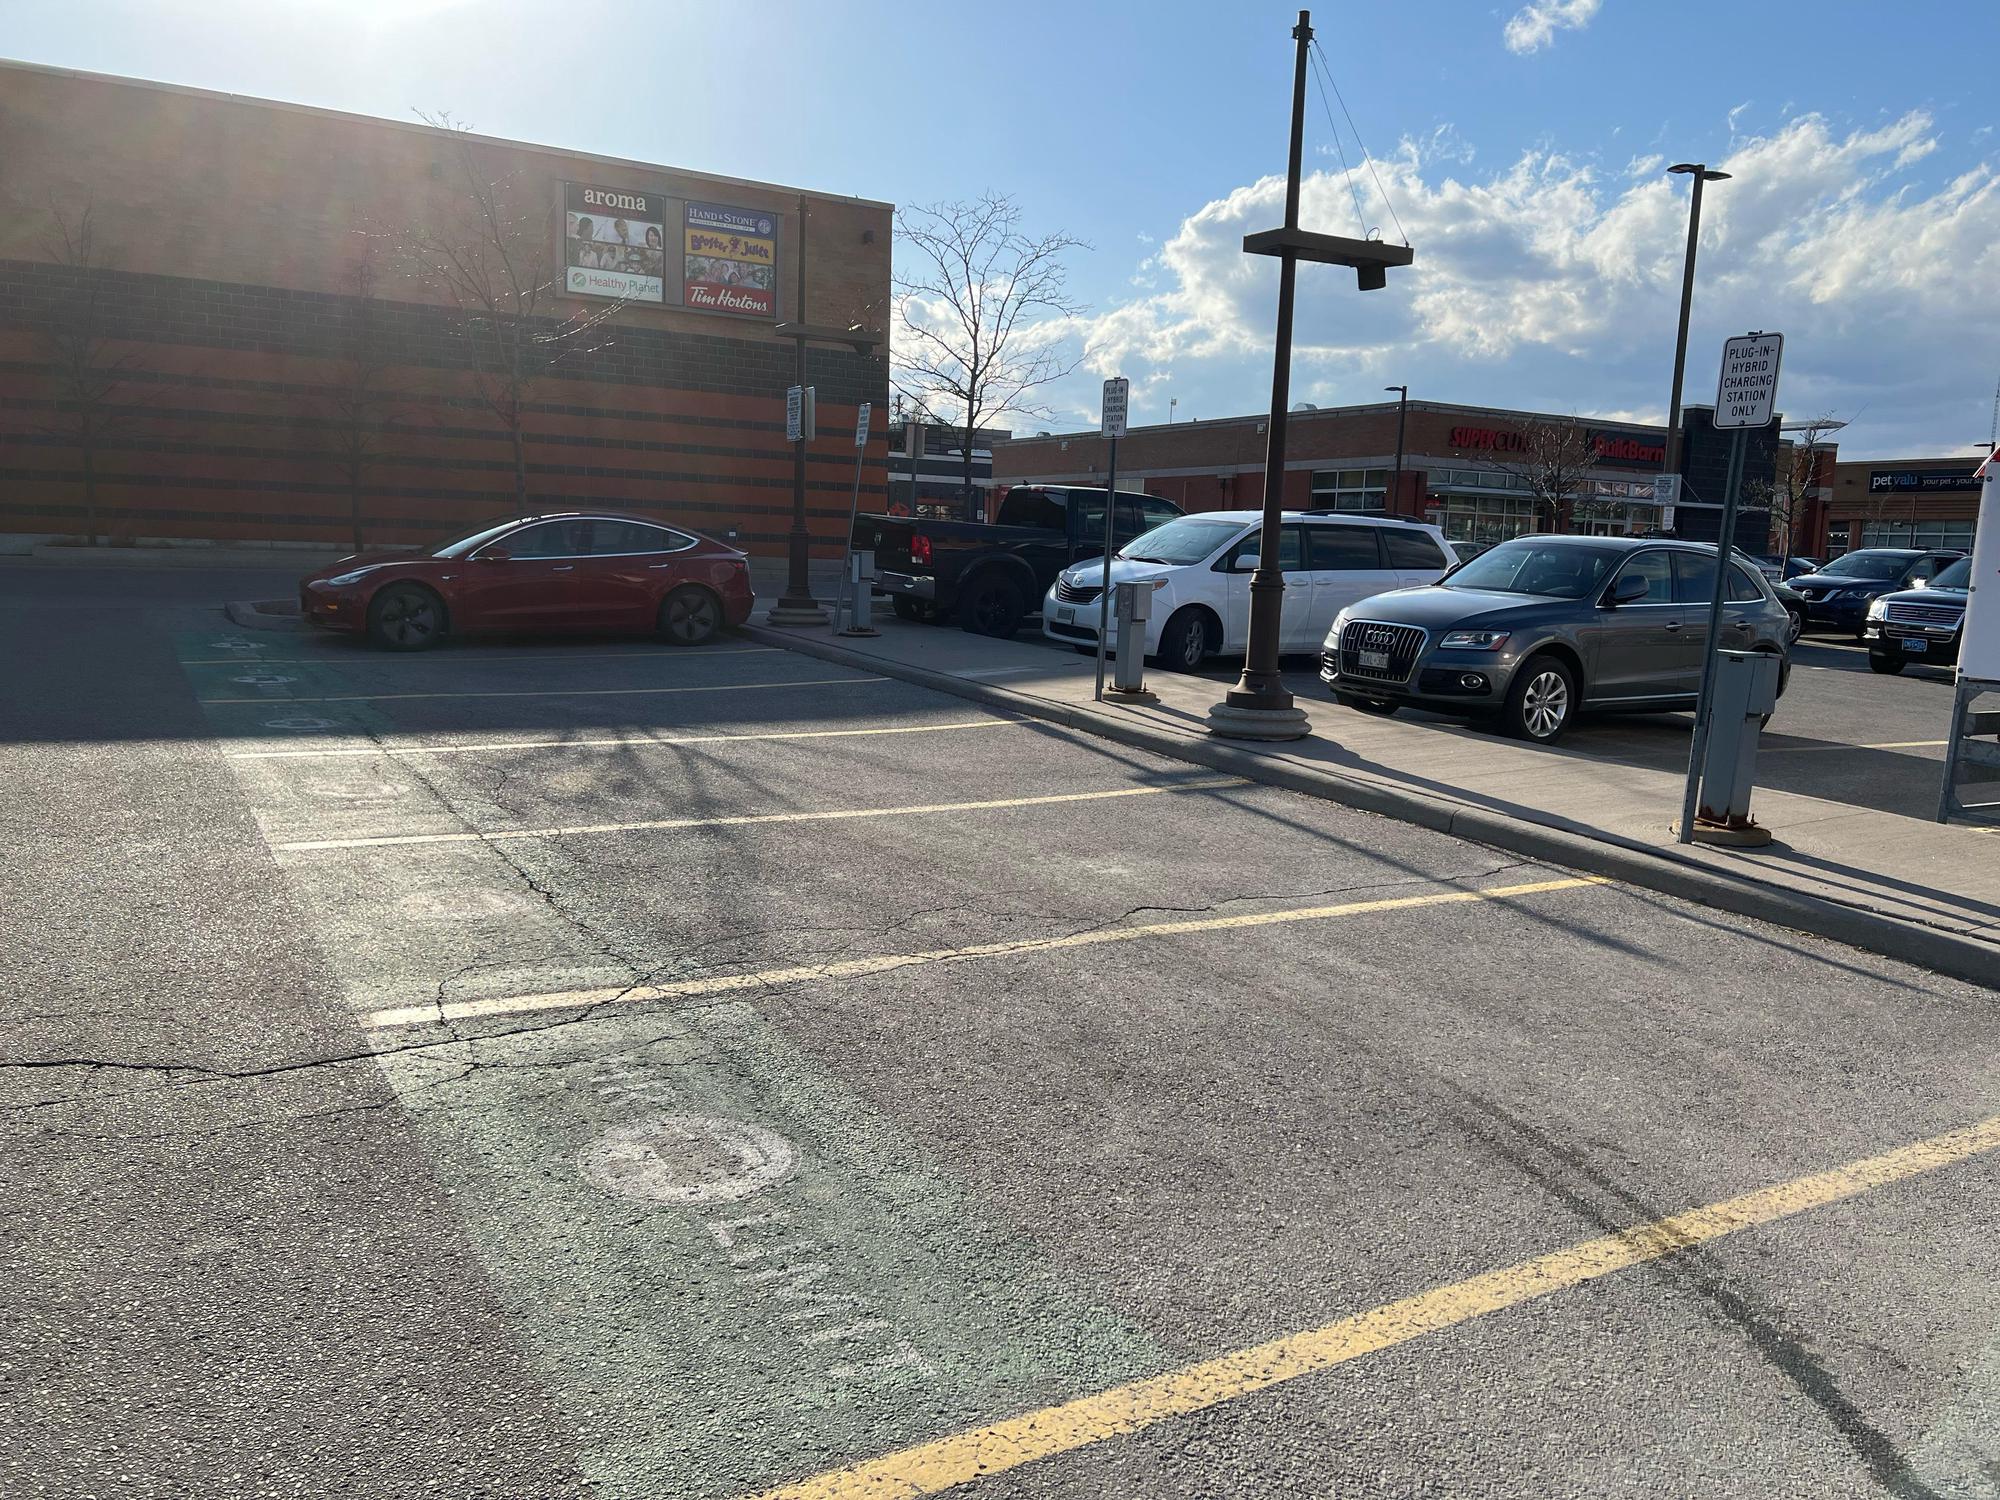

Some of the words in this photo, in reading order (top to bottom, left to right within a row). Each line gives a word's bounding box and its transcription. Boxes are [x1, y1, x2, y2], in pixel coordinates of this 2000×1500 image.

[584, 188, 647, 212] aroma
[690, 234, 729, 252] Booster
[741, 240, 769, 258] Juice
[589, 275, 627, 290] Healthy
[629, 280, 660, 293] Planet
[690, 286, 716, 305] Tim
[717, 288, 768, 312] Hortons
[1731, 360, 1768, 373] HYBRID
[1724, 374, 1773, 388] CHARGING
[1726, 389, 1767, 402] STATION
[1731, 404, 1757, 417] ONLY
[1872, 475, 1892, 489] pet
[1892, 474, 1918, 485] valu
[1940, 478, 1951, 486] pet
